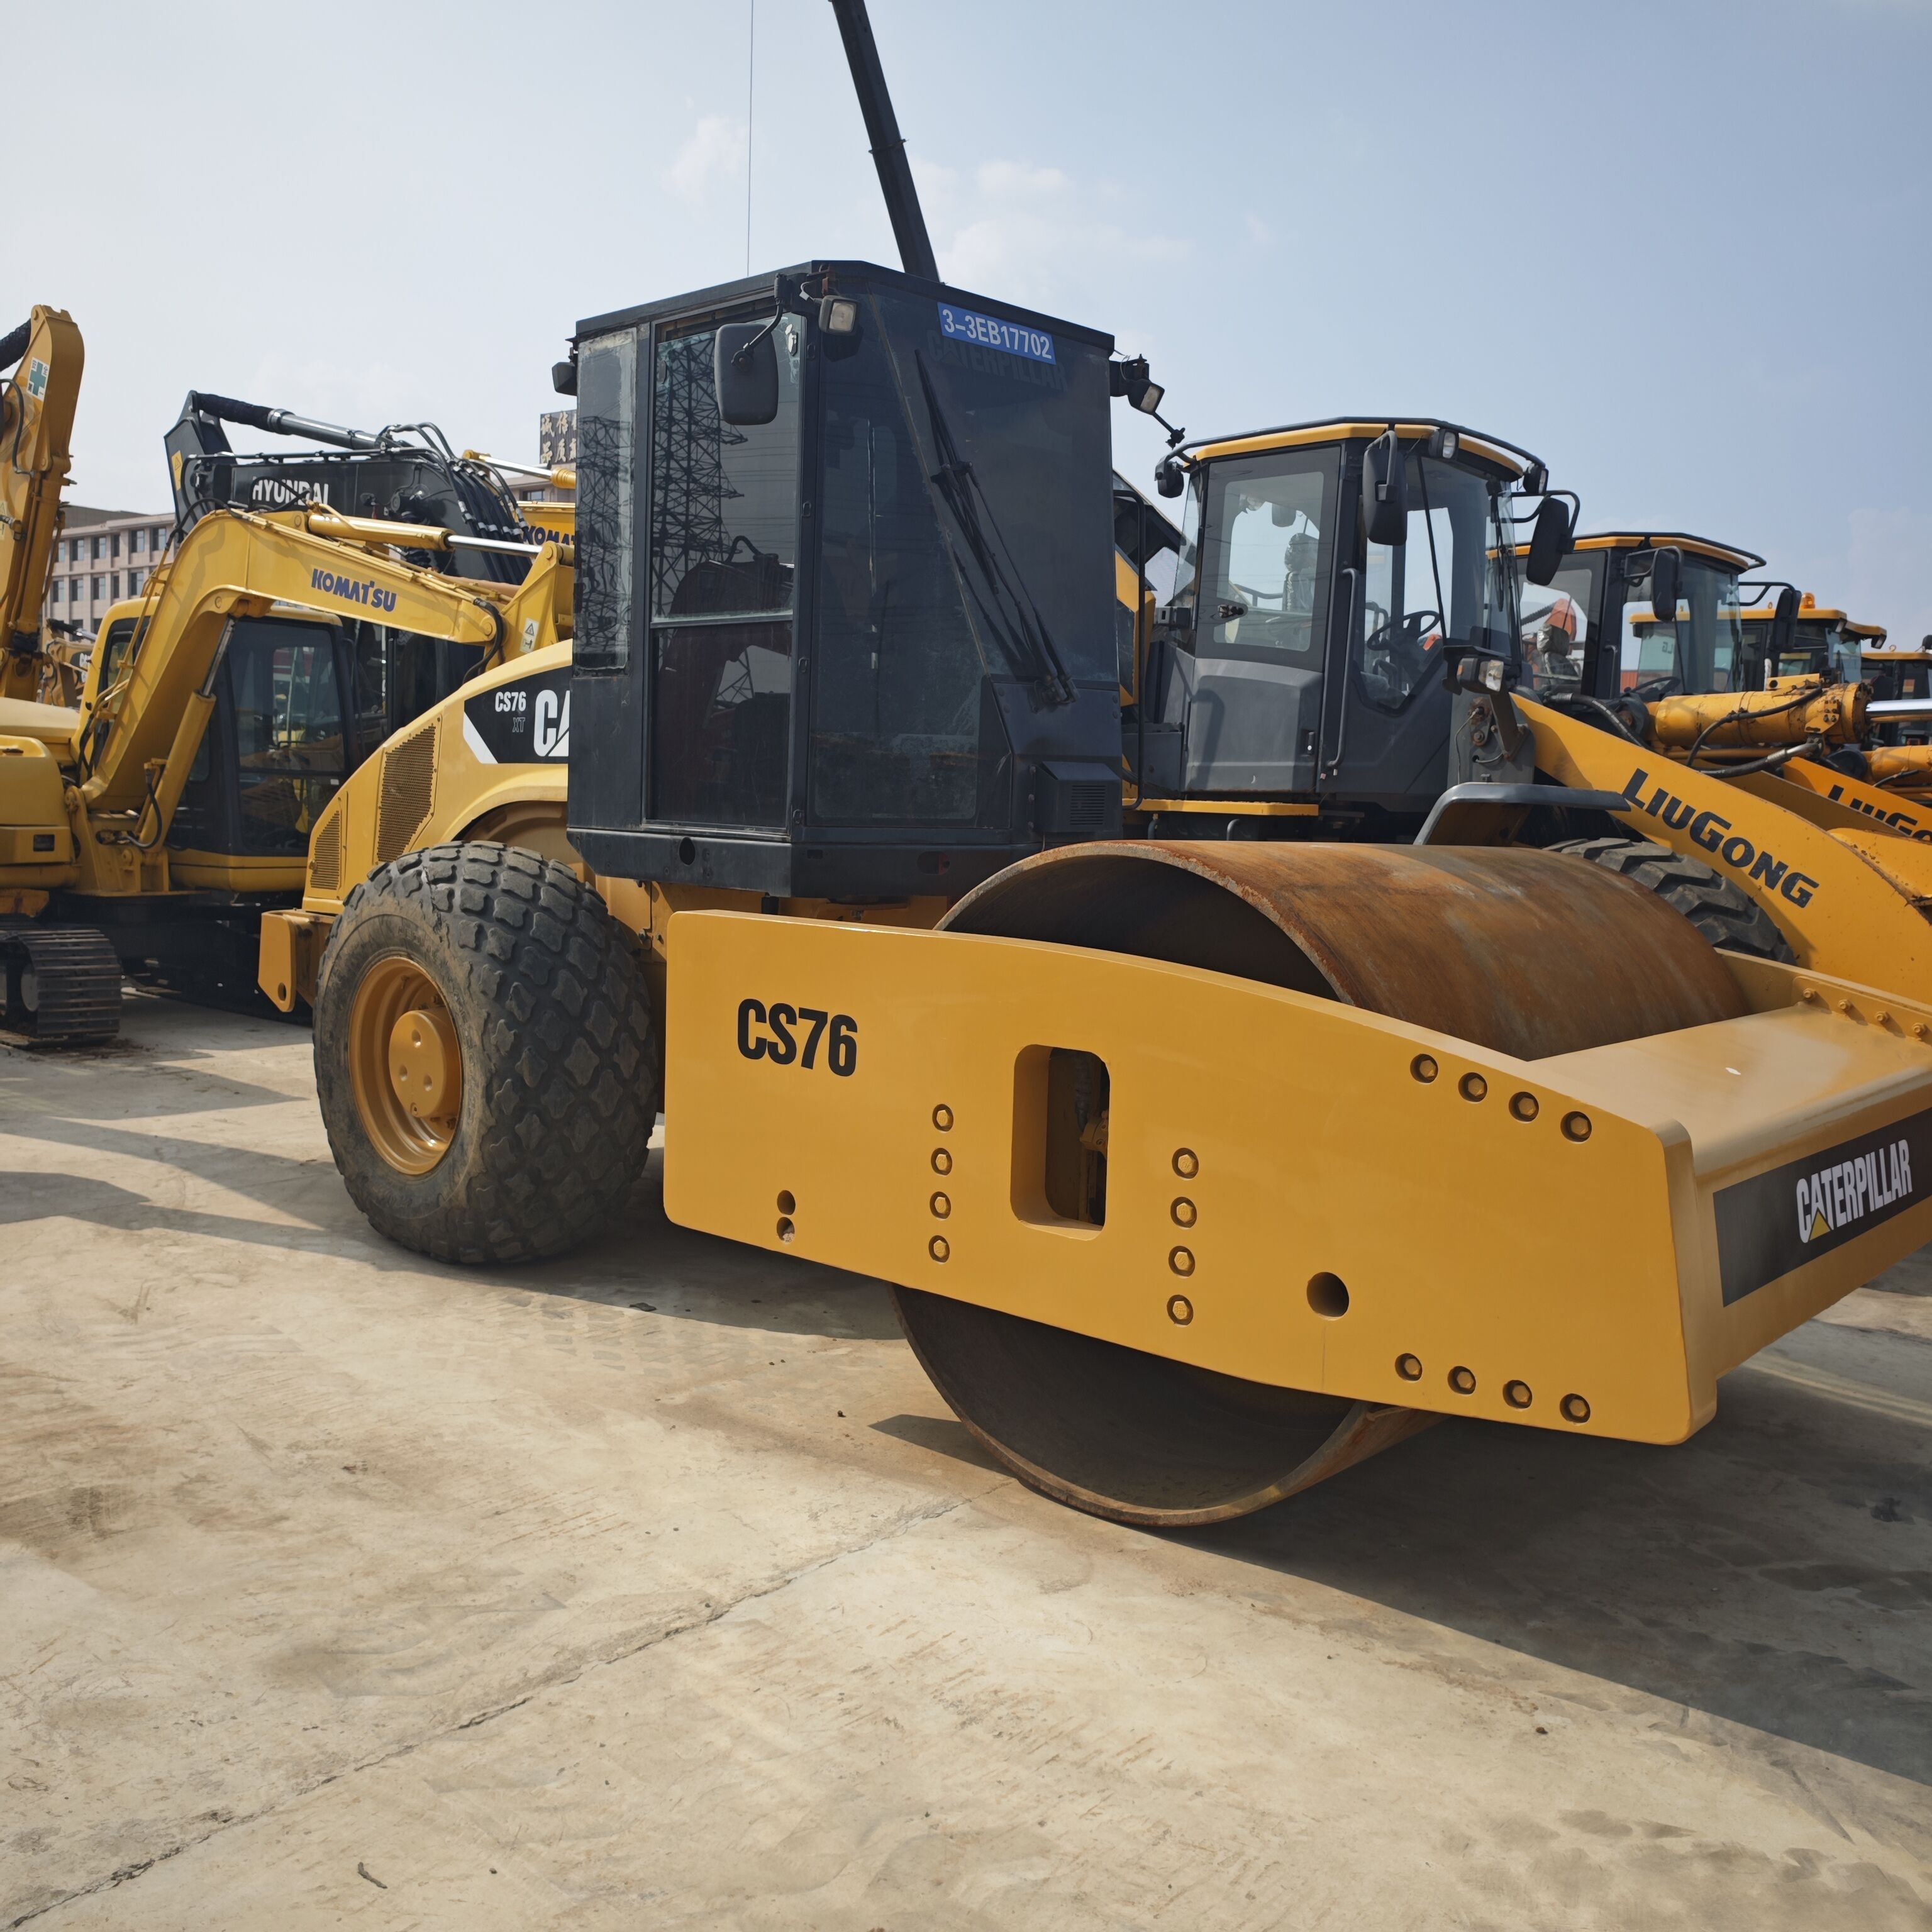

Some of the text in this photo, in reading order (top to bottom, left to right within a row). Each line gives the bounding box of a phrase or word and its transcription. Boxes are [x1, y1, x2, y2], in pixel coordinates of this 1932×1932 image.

[942, 309, 1052, 359] 3-3EB17702
[252, 476, 329, 506] HYUNDAI
[523, 525, 575, 545] KOMA
[311, 568, 397, 613] KOMATSU
[495, 691, 526, 712] CS76
[512, 717, 526, 733] XT
[1621, 768, 1819, 908] LIUGONG
[737, 998, 858, 1077] CS76
[1796, 1139, 1913, 1243] CATERPILLAR
